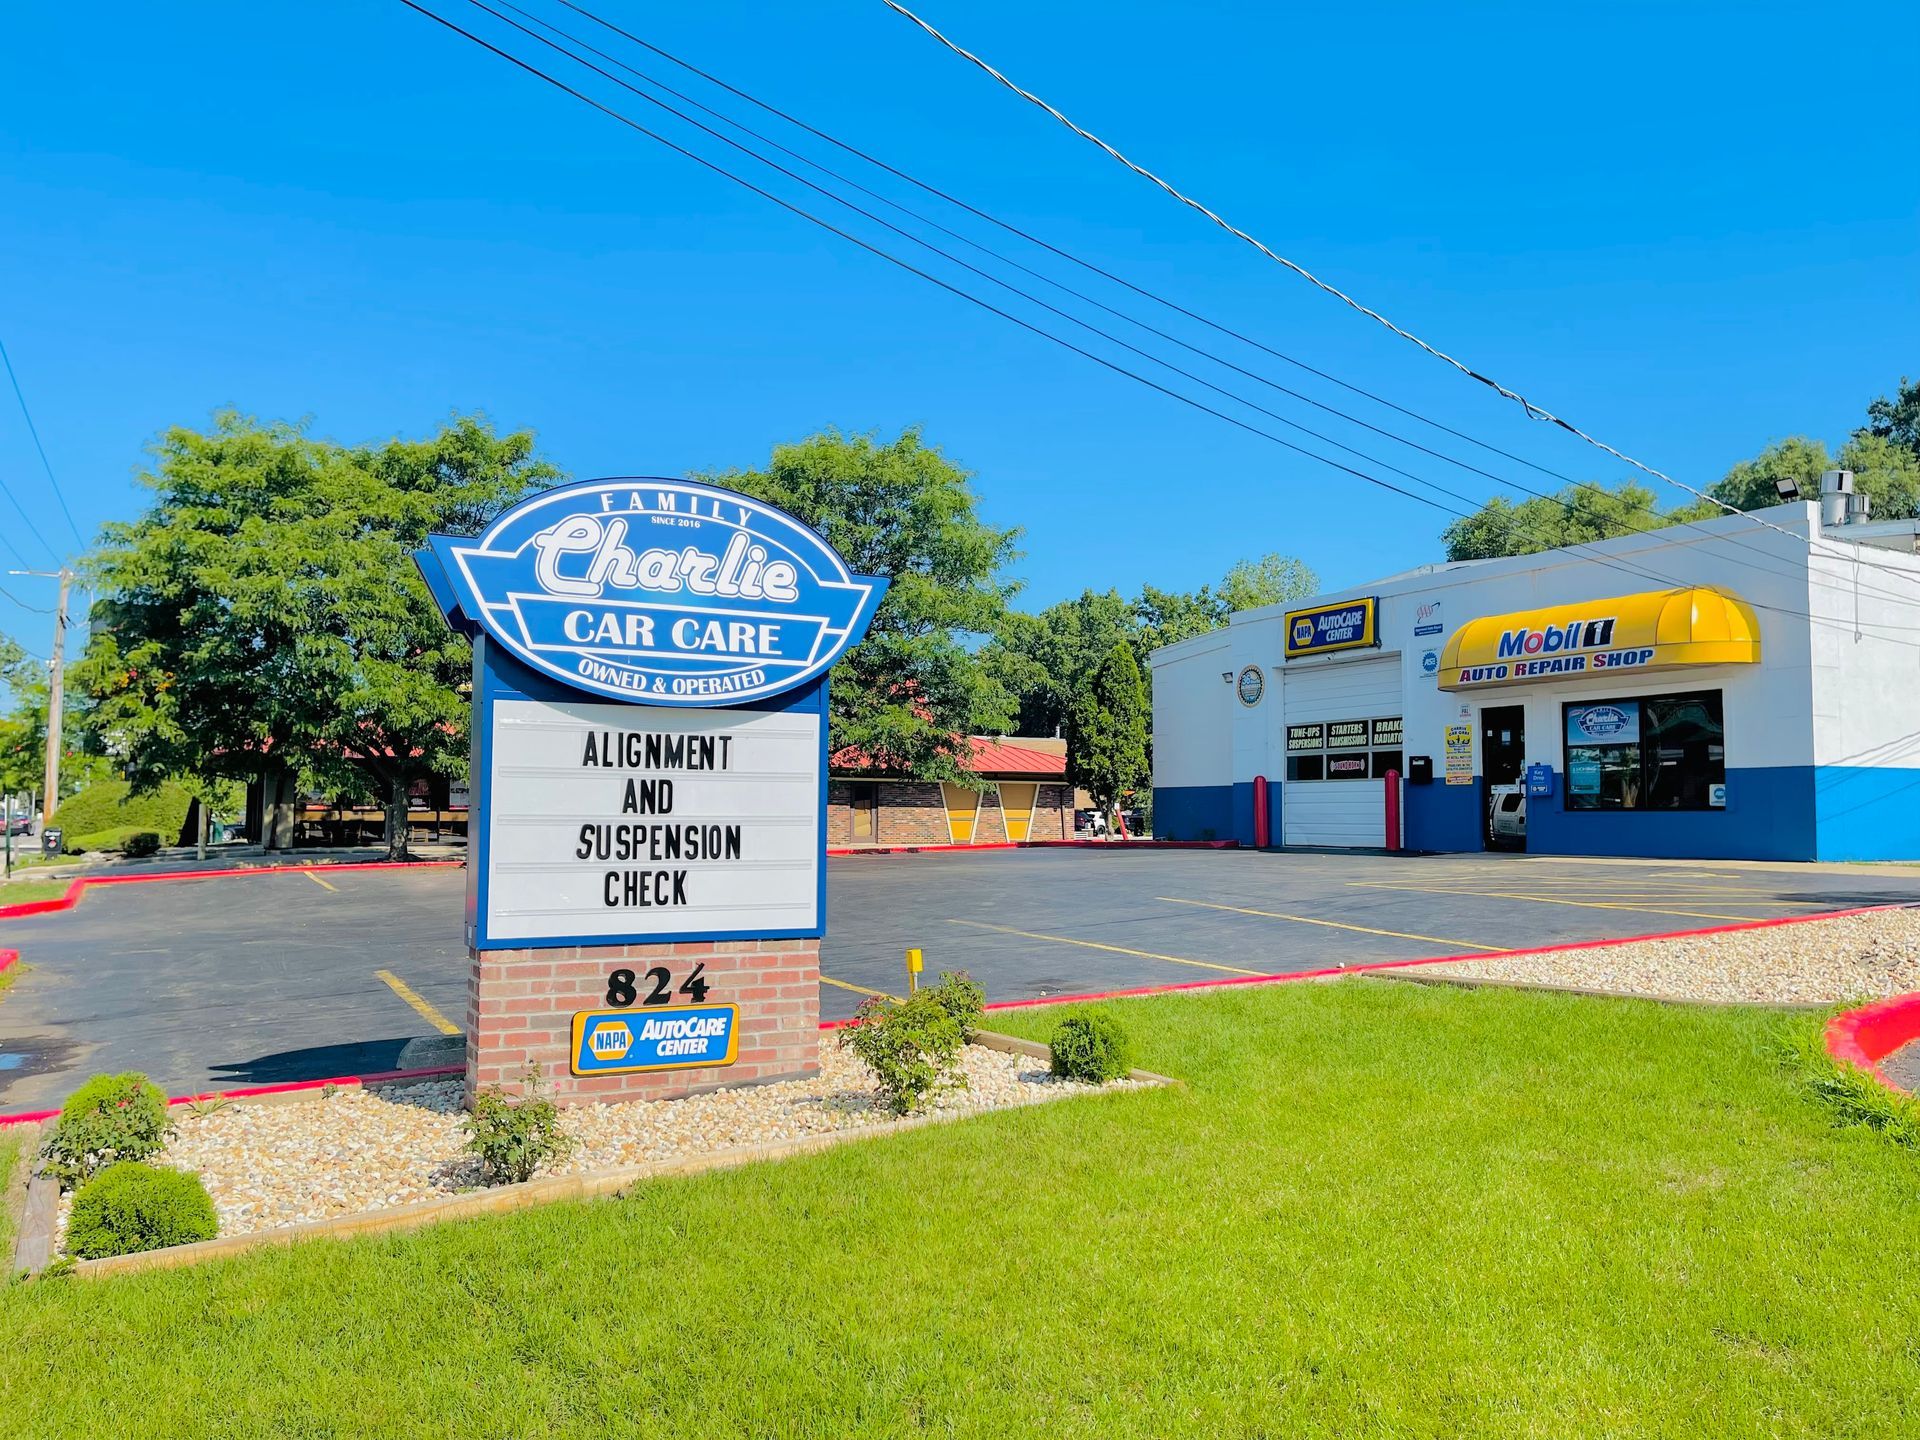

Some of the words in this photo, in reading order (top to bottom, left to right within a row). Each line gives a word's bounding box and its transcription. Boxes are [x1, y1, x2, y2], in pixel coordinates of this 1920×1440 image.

[601, 491, 752, 527] FAMILY
[651, 516, 676, 526] SINCE
[678, 518, 701, 529] 2016
[534, 513, 800, 602] Charlie
[564, 610, 655, 647] CAR
[672, 618, 782, 655] CARE
[1296, 624, 1312, 640] NAPA
[1326, 627, 1353, 642] CENTER
[1498, 621, 1583, 658] Mobil
[578, 658, 647, 690] OWNED
[652, 677, 667, 694] &
[672, 669, 765, 695] OPERATED
[1459, 665, 1508, 683] AUTO
[1514, 657, 1585, 677] REPAIR
[1593, 649, 1654, 668] SHOP
[1288, 737, 1323, 750] SUSPENSIONS
[1290, 727, 1320, 739] TUNE-UPS
[1328, 735, 1367, 747] TRANSMISSIONS
[1331, 723, 1364, 736] STARTERS
[582, 731, 732, 771] ALIGNMENT
[622, 778, 674, 815] AND
[576, 824, 741, 860] SUSPENSION
[604, 870, 688, 906] CHECK
[606, 962, 710, 1008] 824
[596, 1031, 627, 1050] NAPA
[656, 1037, 708, 1057] CENTER
